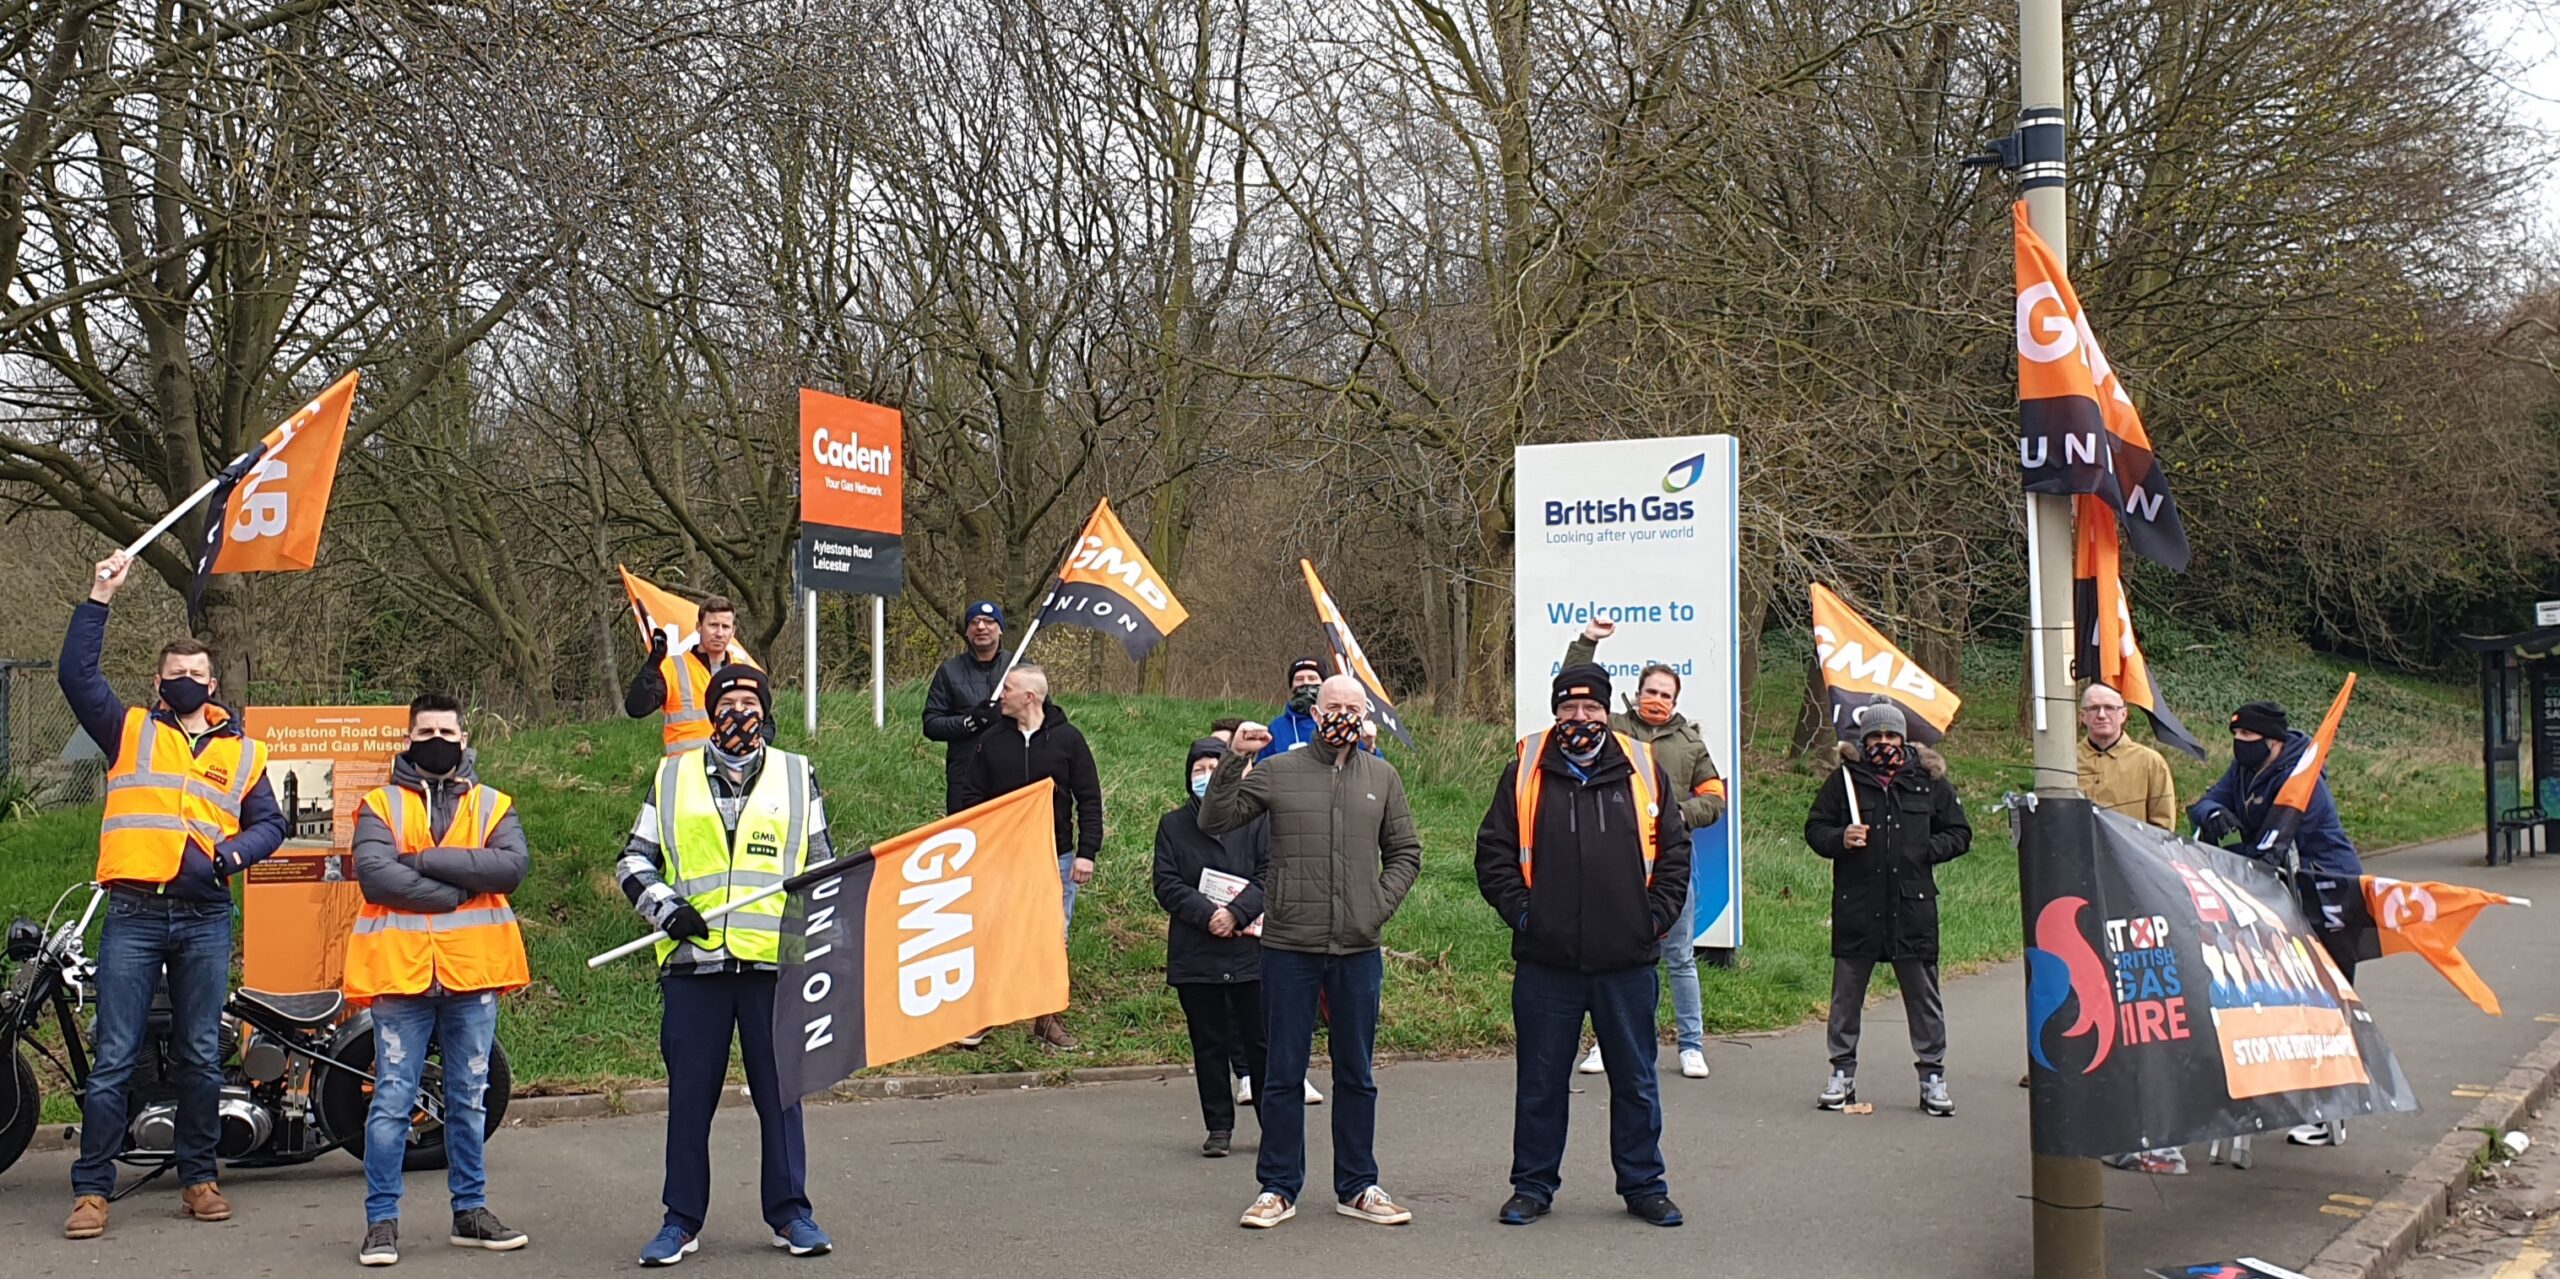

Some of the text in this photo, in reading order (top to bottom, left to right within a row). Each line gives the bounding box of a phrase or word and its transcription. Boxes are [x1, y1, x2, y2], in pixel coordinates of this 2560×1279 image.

[812, 427, 891, 475] Cadent
[824, 476, 882, 496] Your Gas Network
[1545, 496, 1694, 526] British Gas
[1546, 526, 1694, 545] Looking after your world
[813, 540, 873, 559] Aylestone Road
[813, 556, 850, 572] Leicester
[1067, 535, 1168, 610] GMB
[1547, 601, 1694, 624] Welcome to
[1550, 660, 1640, 678] Atone
[1814, 625, 1937, 700] GMB
[266, 725, 409, 741] Aylestone Road Gas
[266, 741, 296, 752] orks
[301, 741, 327, 752] and
[331, 740, 359, 752] Gas
[752, 831, 776, 842] GMB
[898, 827, 977, 1017] GMB
[2106, 915, 2169, 952] STOP
[802, 876, 843, 1053] UNION
[2120, 965, 2182, 1001] GAS
[2233, 1037, 2269, 1066] STOP
[2268, 1035, 2292, 1061] THE
